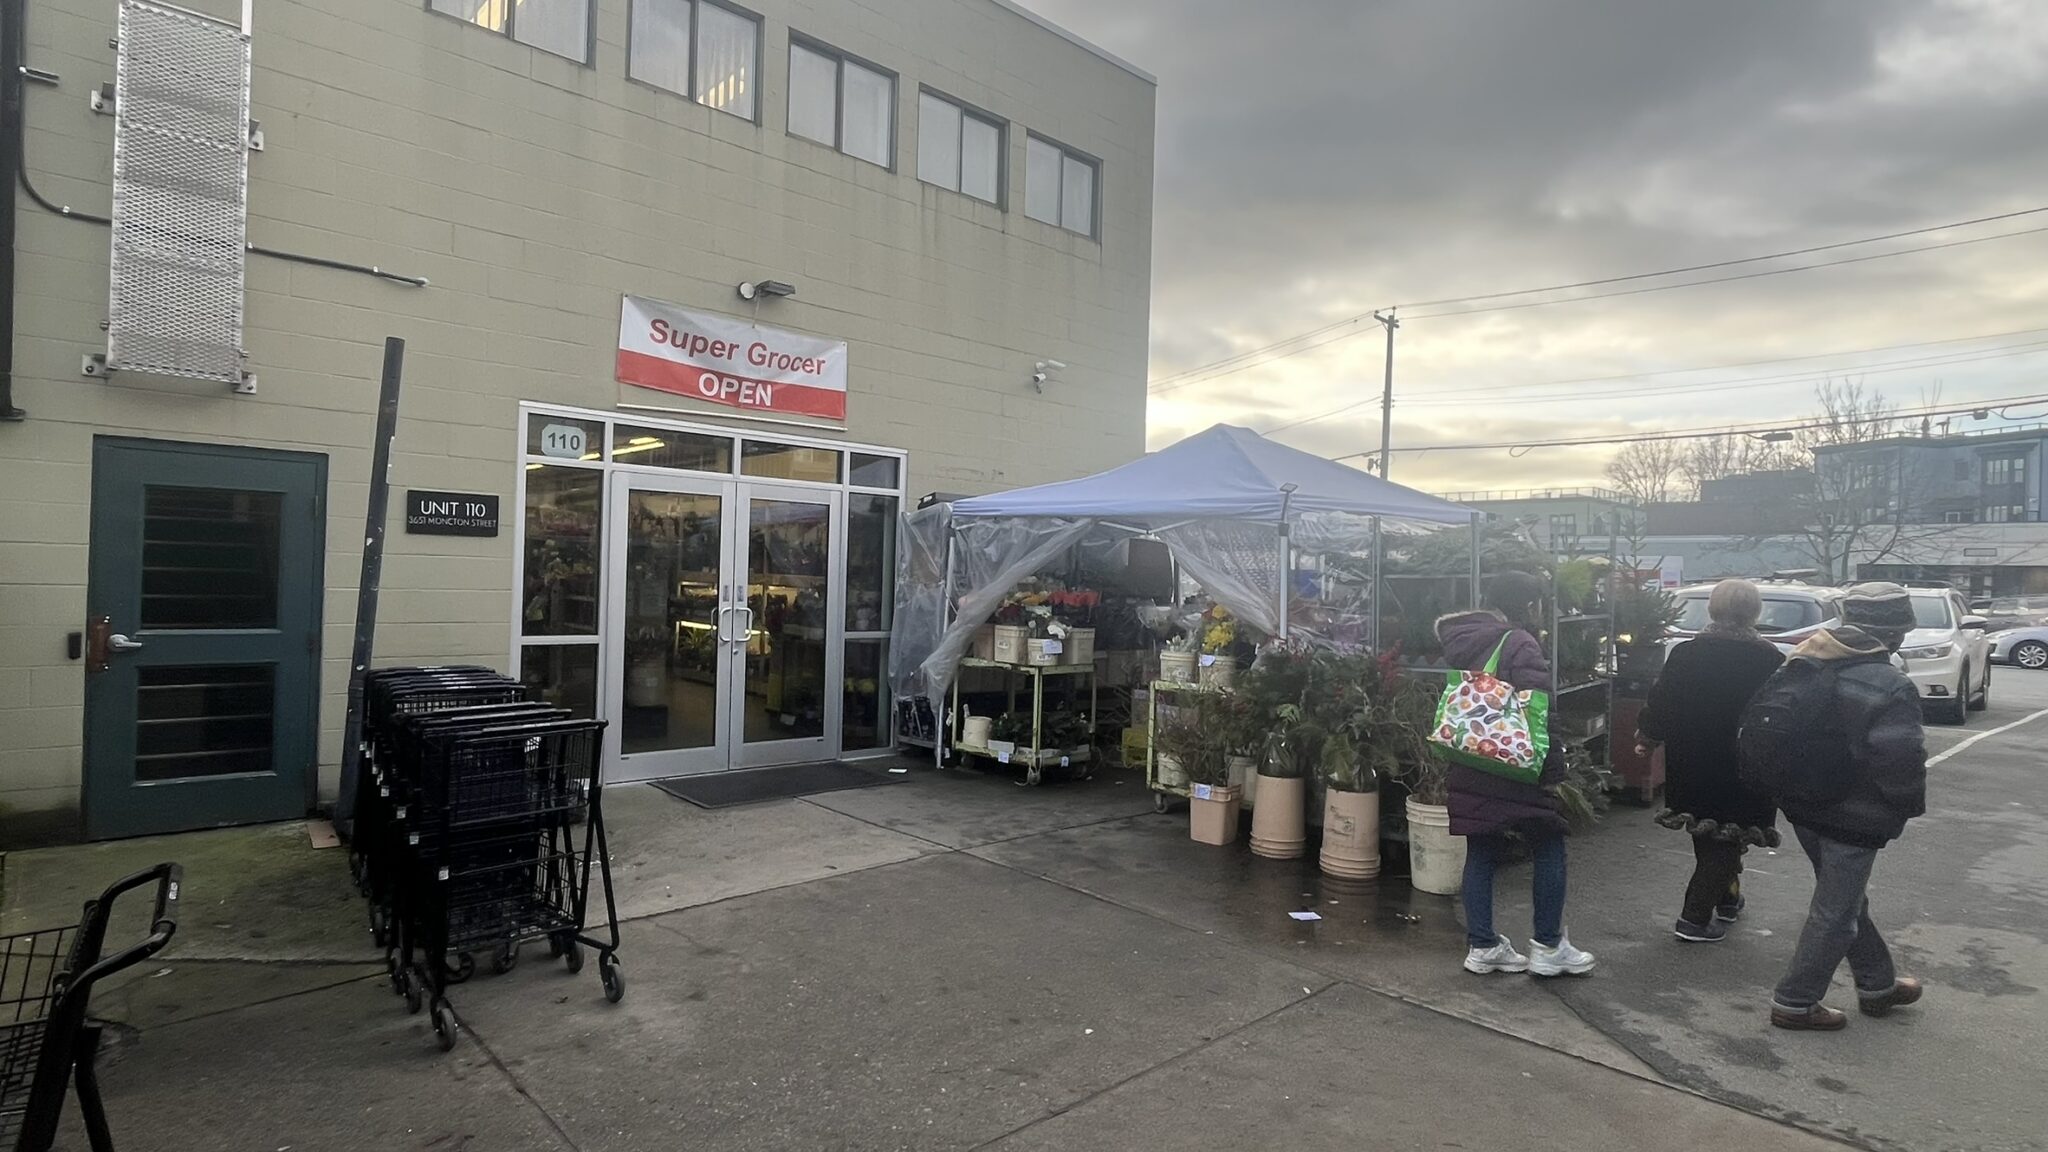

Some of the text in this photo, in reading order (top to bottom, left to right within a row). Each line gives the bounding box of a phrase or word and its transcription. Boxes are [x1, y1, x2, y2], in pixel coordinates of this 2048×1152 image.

[649, 318, 826, 376] Super Grocer
[698, 373, 772, 407] OPEN
[548, 432, 580, 451] 110
[421, 500, 486, 517] UNIT 110
[408, 516, 497, 528] 3651 MONCTON STREET
